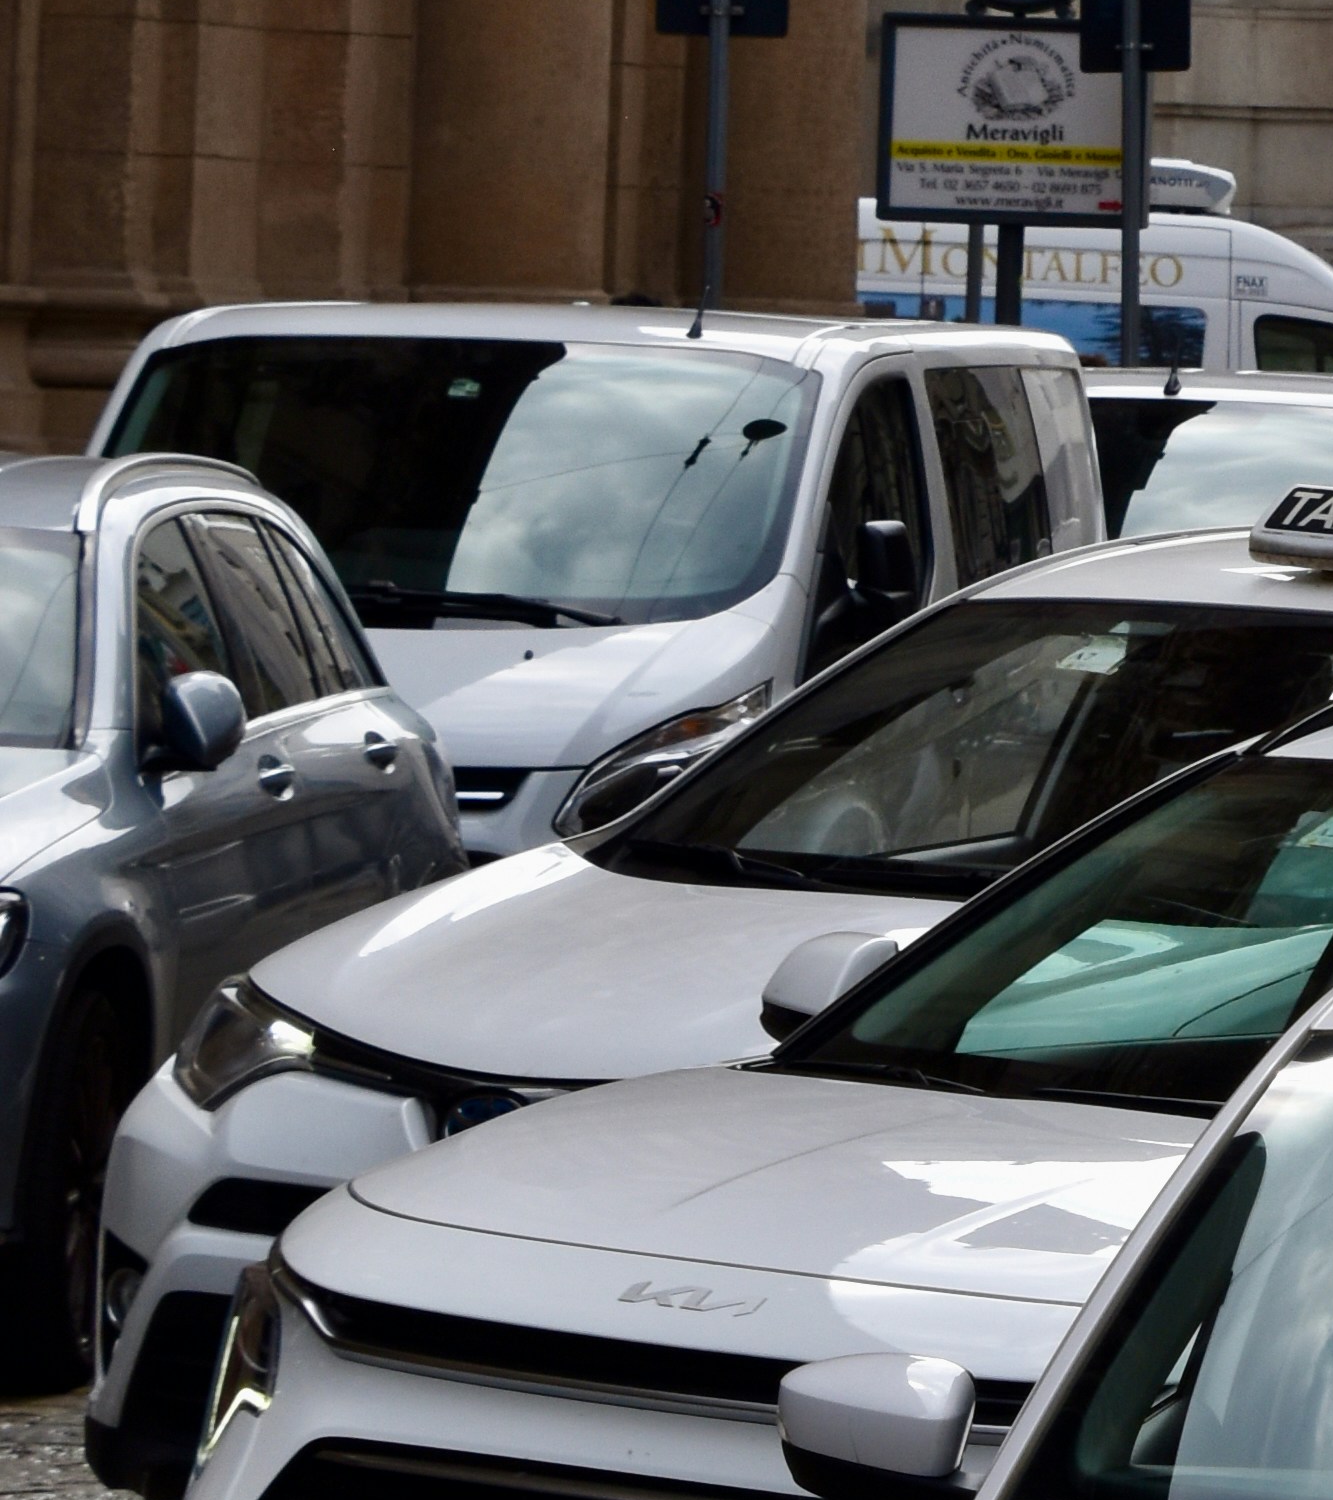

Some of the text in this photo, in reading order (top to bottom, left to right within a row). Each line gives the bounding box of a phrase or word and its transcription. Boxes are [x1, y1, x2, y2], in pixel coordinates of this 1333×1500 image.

[966, 123, 1064, 145] Meravigli
[956, 146, 996, 158] Vendita
[1085, 152, 1122, 161] Monet
[897, 162, 915, 173] Via
[932, 163, 965, 174] Maria
[1059, 168, 1110, 181] Meravigli
[1149, 176, 1193, 188] ANOTTI
[1236, 276, 1265, 288] FNAX
